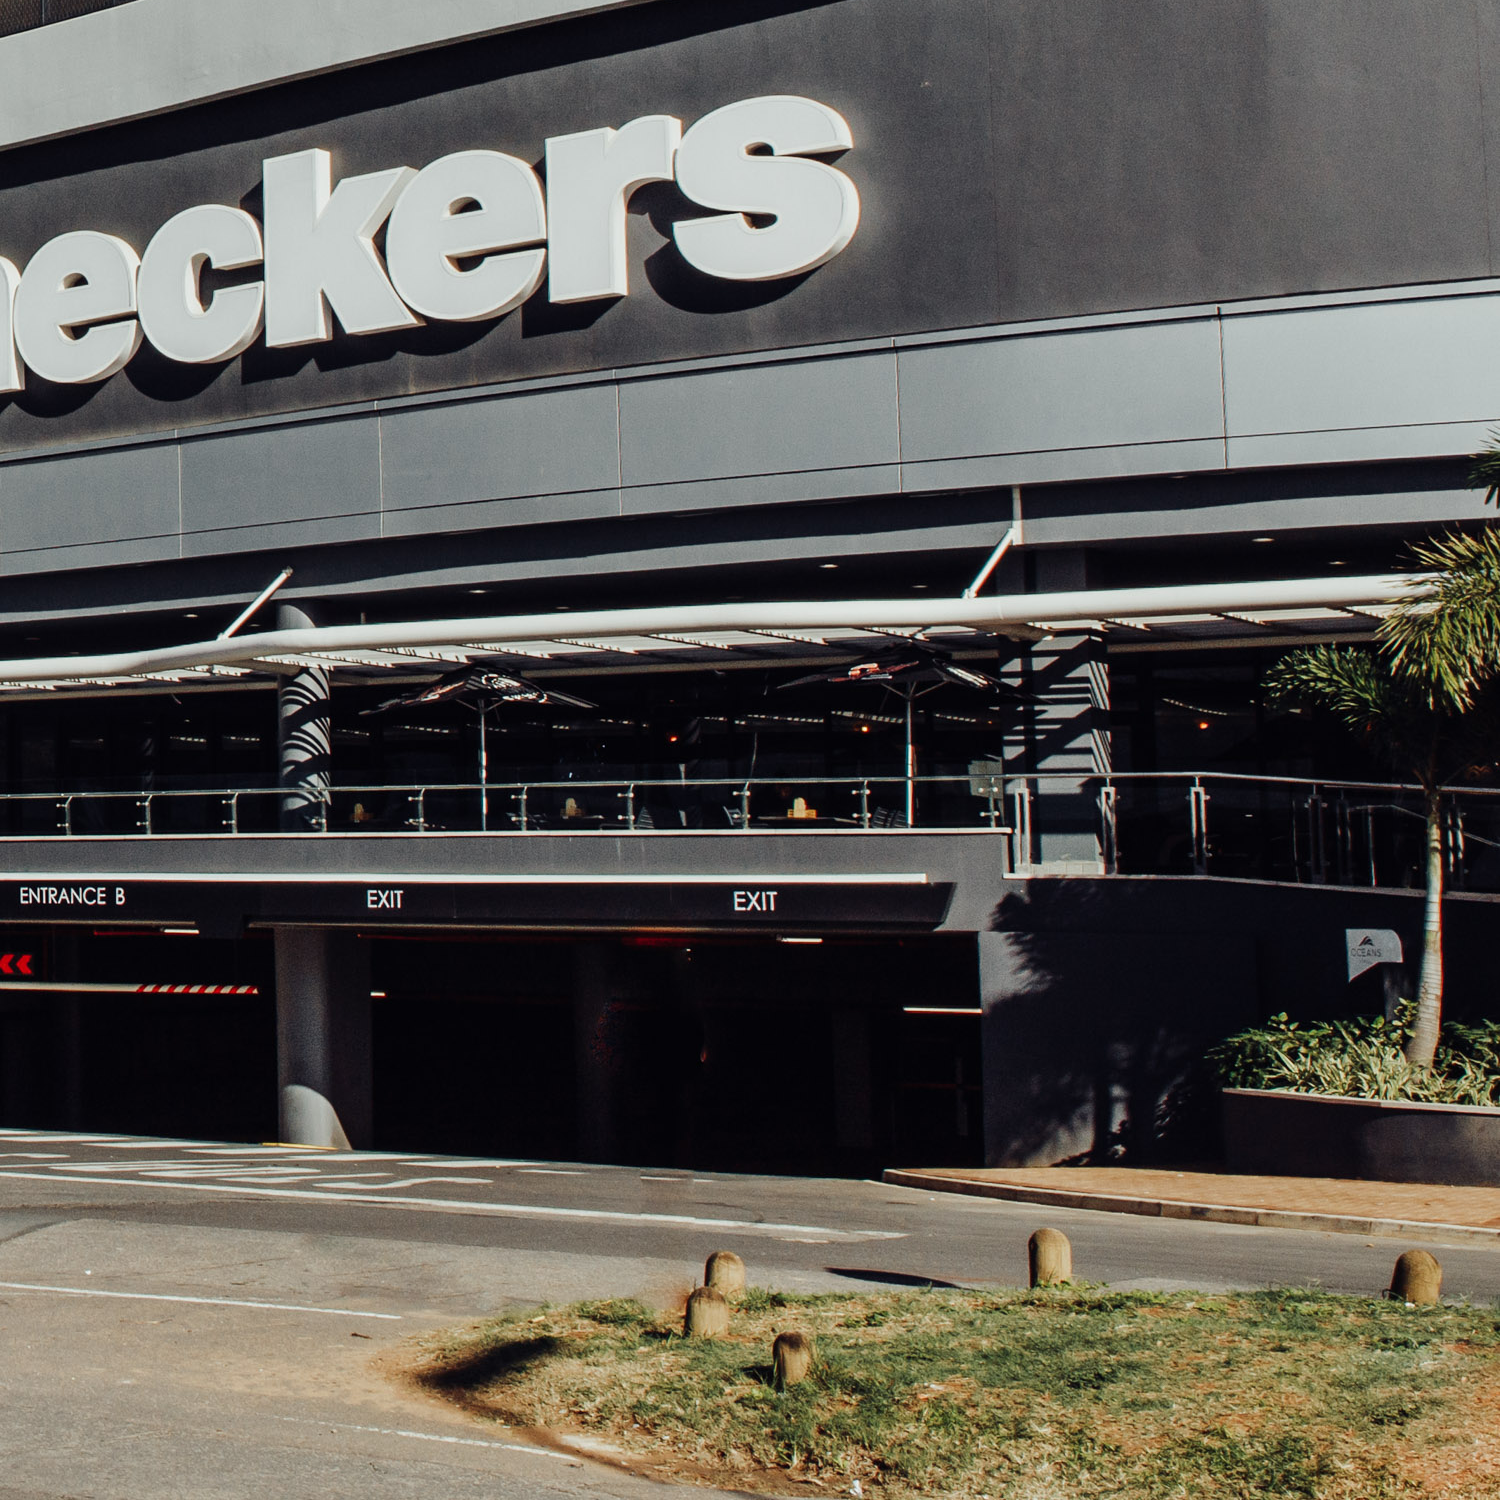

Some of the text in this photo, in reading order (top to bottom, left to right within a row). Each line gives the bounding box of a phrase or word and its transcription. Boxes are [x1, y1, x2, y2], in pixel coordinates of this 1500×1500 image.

[20, 886, 126, 905] ENTRANCE B
[366, 889, 405, 909] EXIT
[733, 891, 779, 912] EXIT
[1350, 947, 1383, 958] OCEANS
